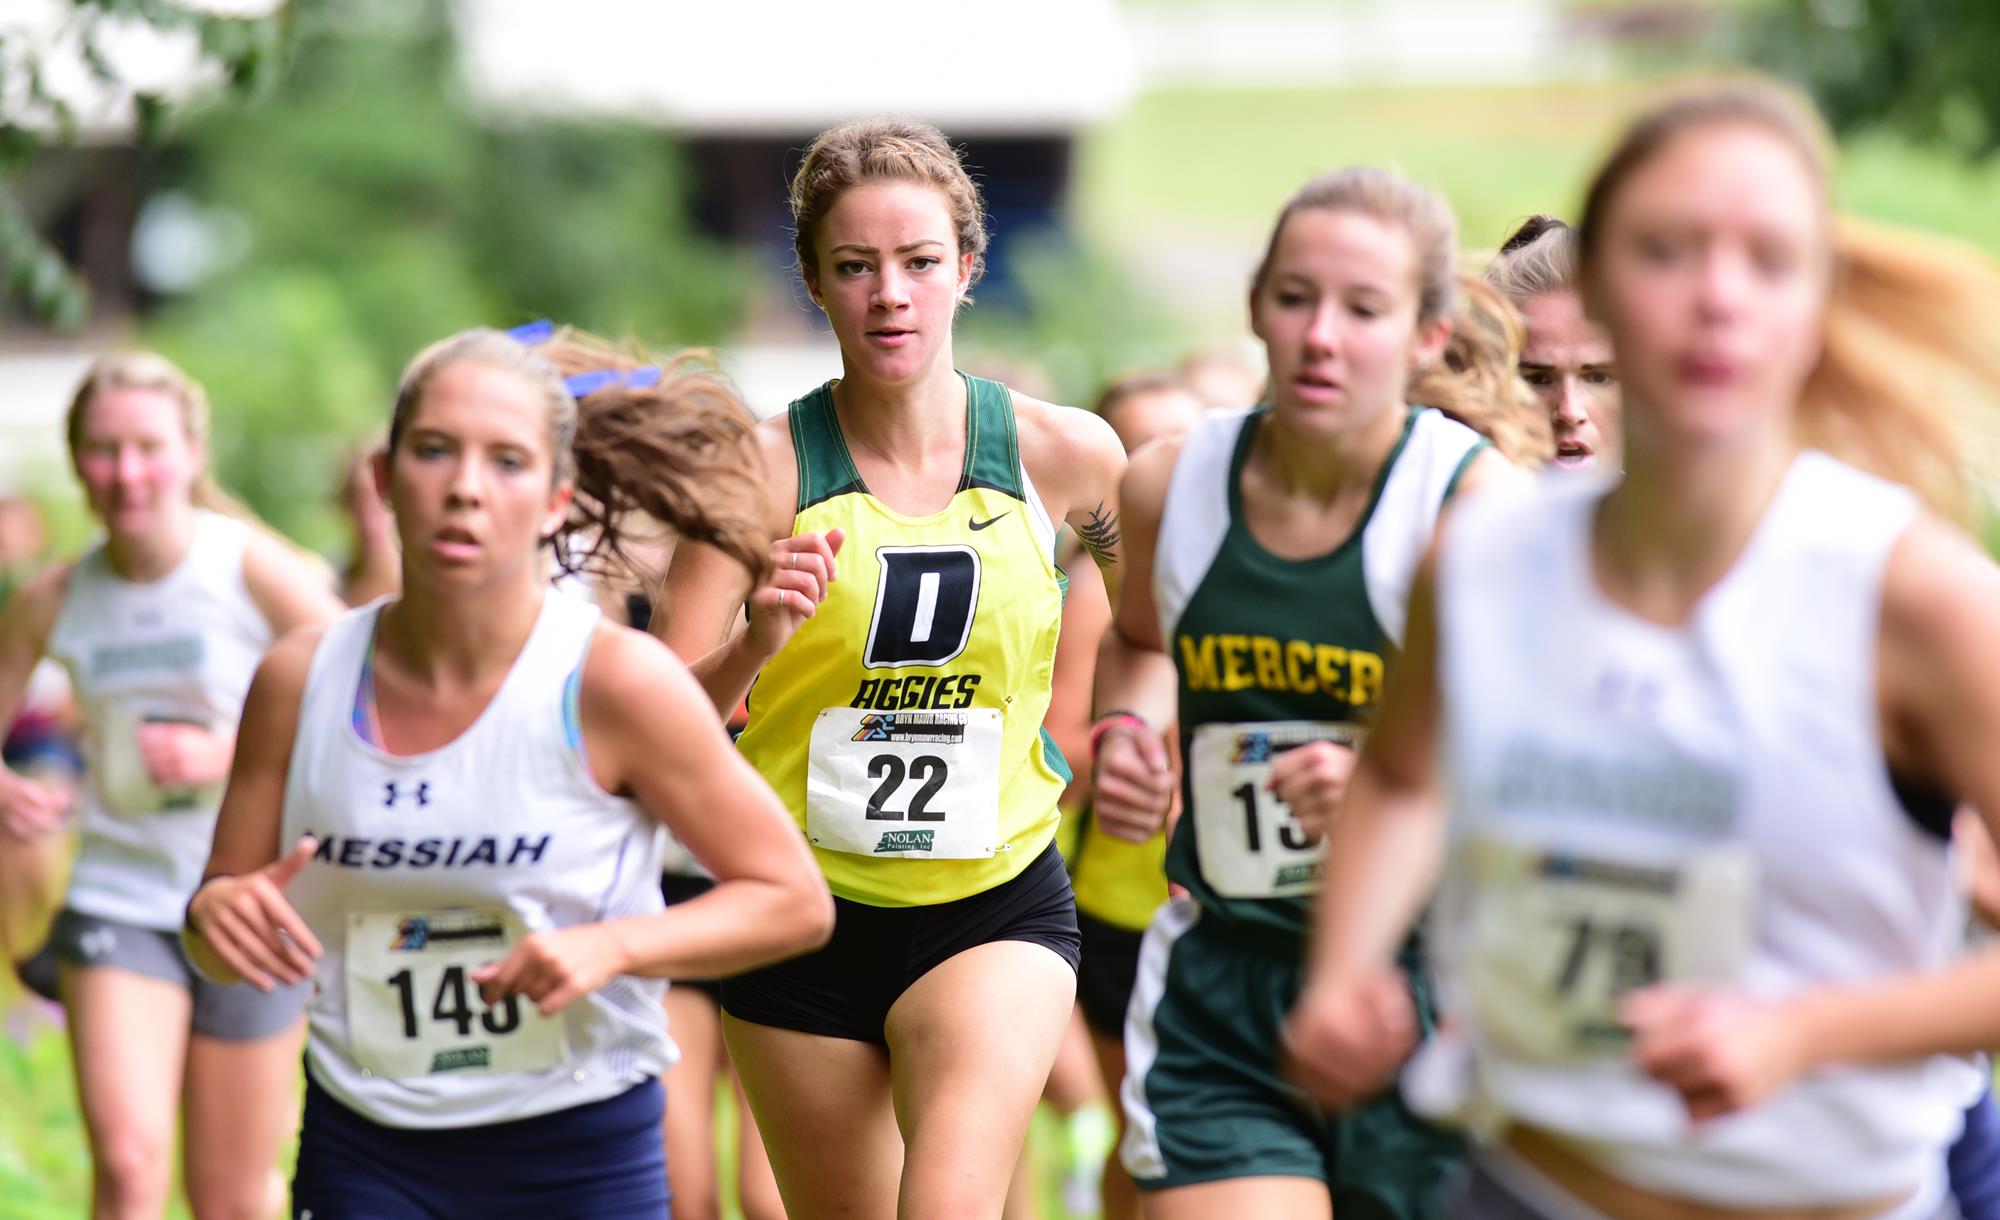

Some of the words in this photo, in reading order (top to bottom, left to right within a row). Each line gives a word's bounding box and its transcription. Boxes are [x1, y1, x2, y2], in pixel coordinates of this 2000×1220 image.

[863, 545, 982, 670] D
[1179, 634, 1385, 706] MERCER
[850, 674, 982, 710] AGGIES
[895, 713, 912, 725] BRYN
[934, 713, 959, 726] RACING
[865, 754, 949, 822] 22
[302, 830, 551, 870] MESSIAH
[888, 833, 931, 843] NOLAN
